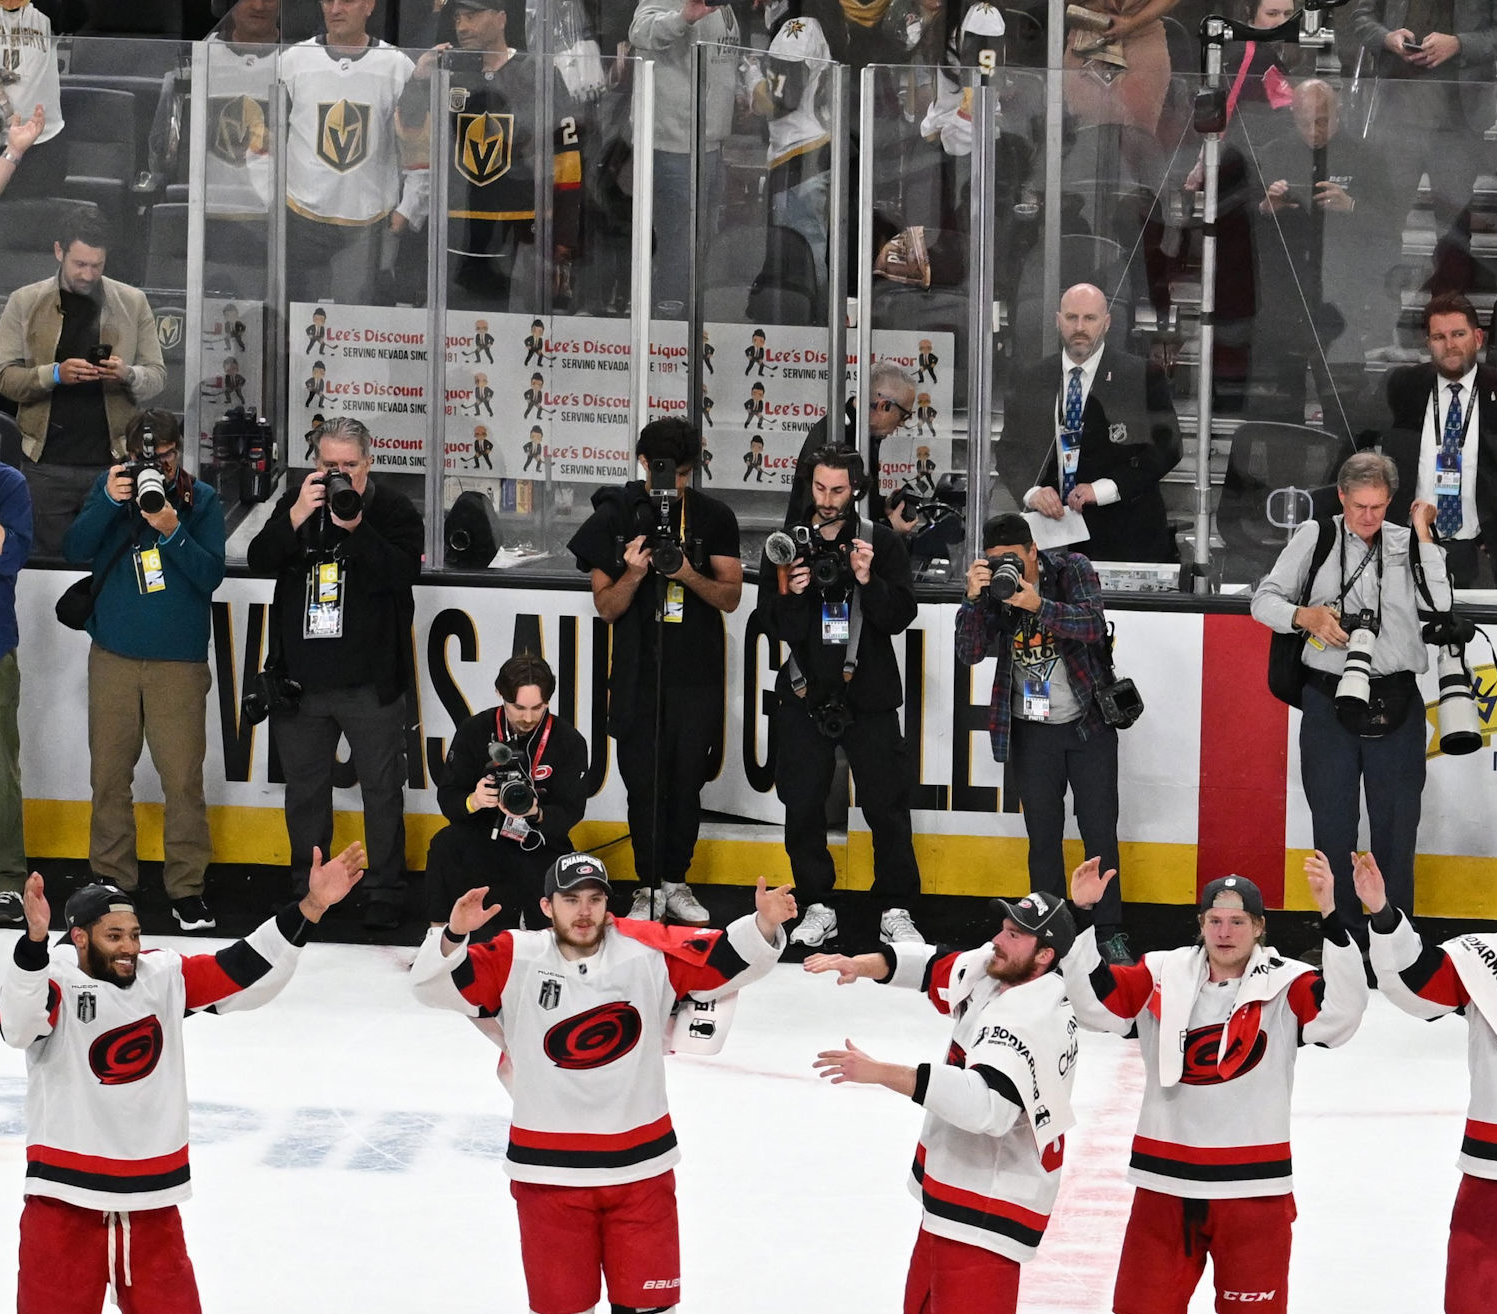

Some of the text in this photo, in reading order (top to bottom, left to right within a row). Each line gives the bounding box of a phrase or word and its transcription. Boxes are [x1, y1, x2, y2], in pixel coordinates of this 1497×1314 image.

[978, 49, 996, 76] 9
[560, 116, 578, 145] 2
[326, 327, 474, 348] Lee's Discount quor
[343, 347, 376, 358] SERVING
[378, 349, 408, 360] NEVADA
[410, 350, 428, 361] SINC
[544, 339, 688, 359] Lee's Discou Liquo
[765, 348, 801, 363] Lee's
[562, 358, 629, 372] SERVING NEVADA
[658, 362, 678, 373] 1981
[783, 368, 816, 380] SERVING
[325, 380, 473, 401] Lee's Discount quor
[342, 400, 375, 412] SERVING
[377, 402, 408, 414] NEVADA
[410, 403, 427, 415] SINC
[543, 392, 687, 412] Lee's Discou Liquo
[764, 401, 800, 416] Lee's
[561, 411, 628, 424] SERVING NEVADA
[444, 443, 473, 455] quor
[543, 444, 629, 461] Lee's Discou
[376, 456, 408, 467] NEVADA
[409, 457, 426, 467] SINC
[879, 461, 915, 474] iquor
[560, 464, 628, 477] SERVING NEVADA
[1223, 1289, 1276, 1302] CCM
